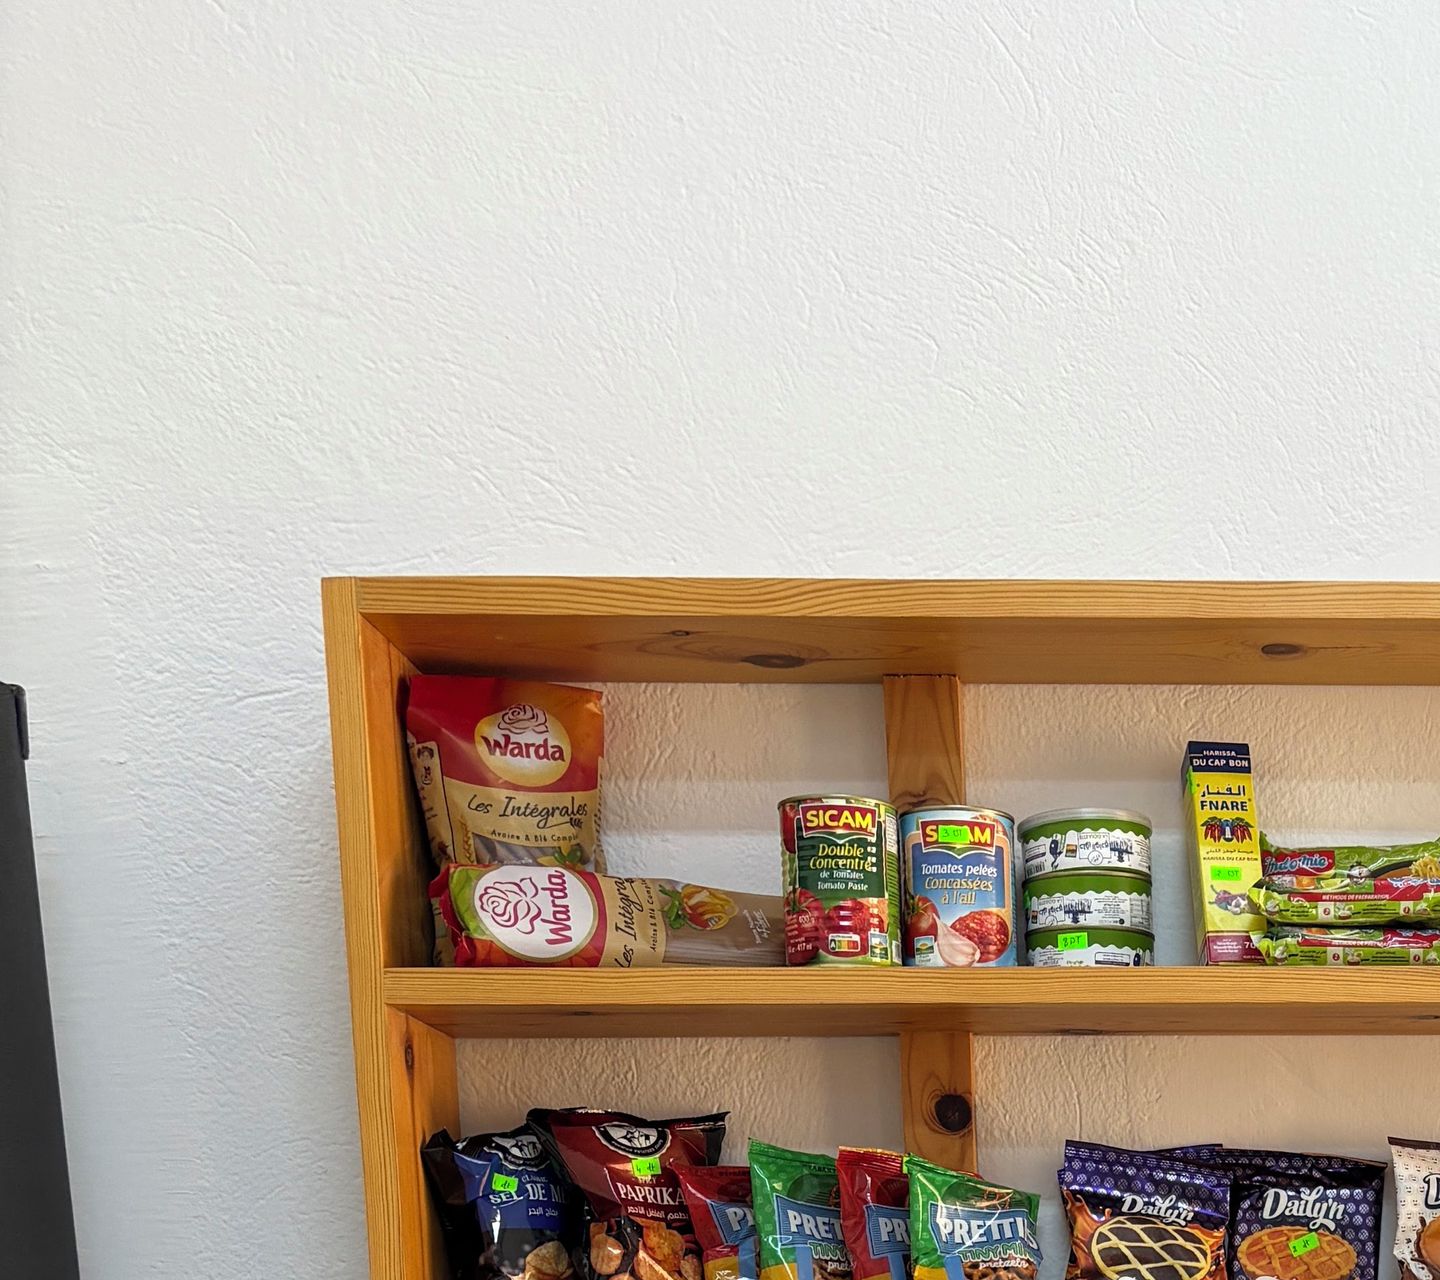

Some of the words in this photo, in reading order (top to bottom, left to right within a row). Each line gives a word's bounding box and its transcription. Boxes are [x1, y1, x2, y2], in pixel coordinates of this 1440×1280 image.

[481, 734, 565, 762] Warda
[1208, 759, 1226, 767] CAP
[468, 795, 492, 814] Les
[1200, 801, 1248, 812] FNARE
[806, 809, 873, 831] SICAM
[819, 843, 864, 857] Double
[810, 857, 872, 871] Concentré
[921, 864, 963, 875] Tomates
[965, 865, 997, 876] pelées
[820, 871, 831, 879] de
[833, 870, 864, 879] Tomates
[818, 882, 846, 890] Tomato
[848, 883, 868, 891] Paste
[925, 877, 993, 891] Concassées
[942, 892, 951, 904] à
[953, 891, 975, 905] l'ail
[541, 870, 573, 945] Warda
[489, 1191, 524, 1203] SEL
[525, 1184, 547, 1200] DE
[616, 1183, 687, 1205] PAPRIKA
[1122, 1194, 1195, 1227] Daily'n
[1262, 1185, 1345, 1232] Daily'n
[957, 1249, 1002, 1262] TINY
